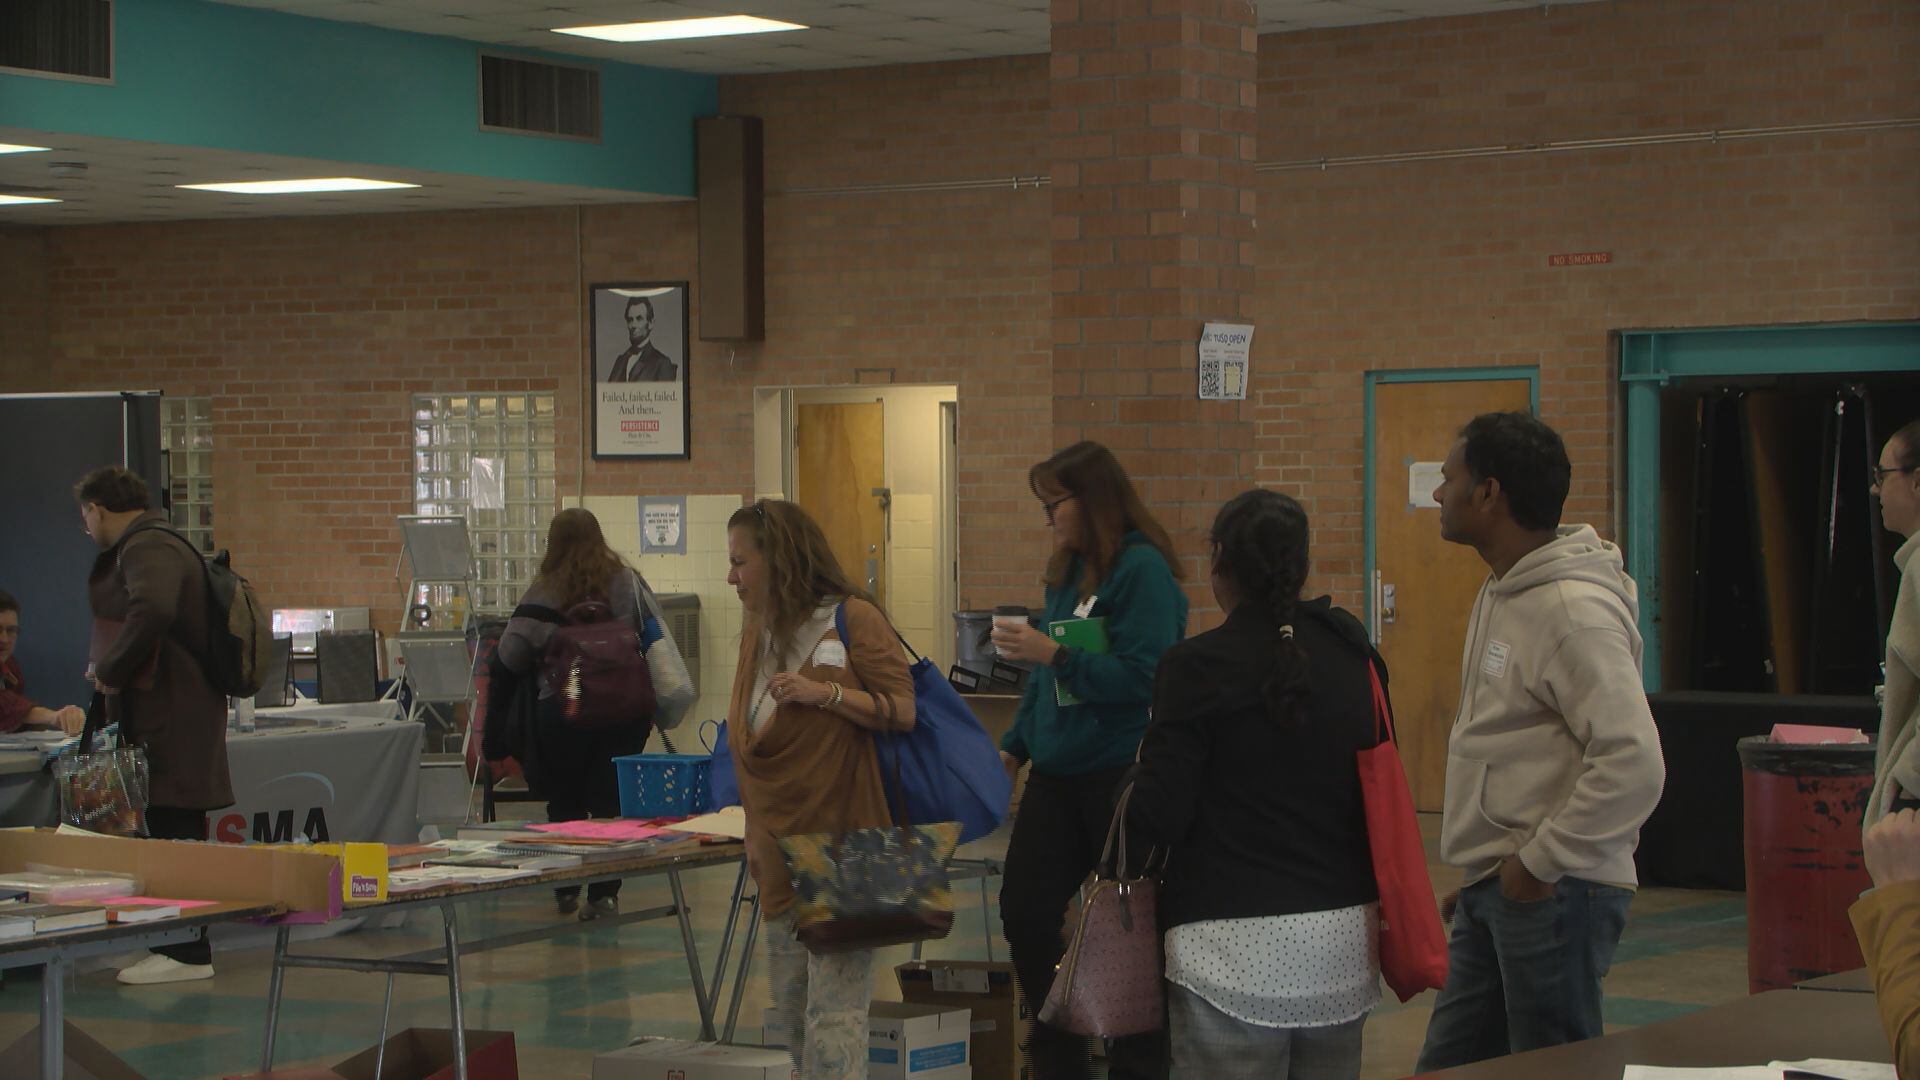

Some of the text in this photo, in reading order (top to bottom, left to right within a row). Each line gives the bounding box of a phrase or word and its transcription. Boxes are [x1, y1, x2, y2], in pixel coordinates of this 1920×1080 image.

[1553, 253, 1607, 265] NO SMOKING
[602, 390, 678, 403] Failed, failed, failed.
[619, 404, 661, 415] And then...
